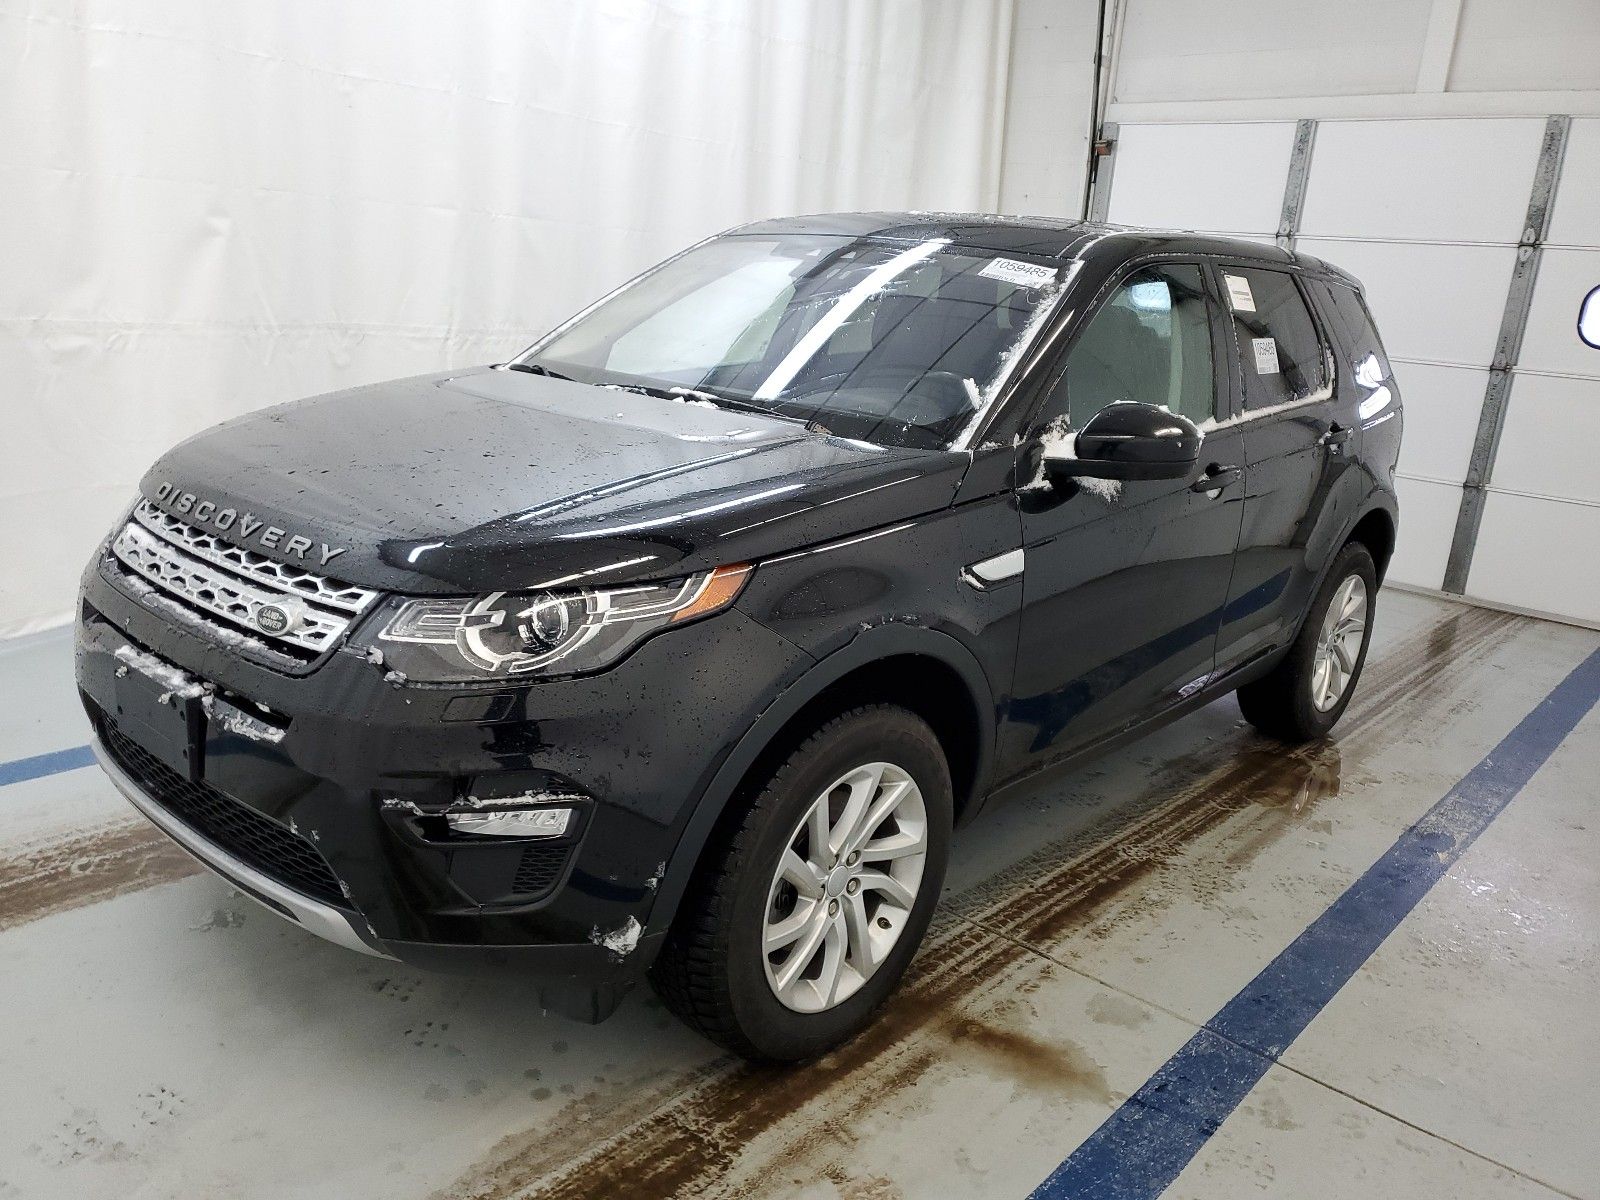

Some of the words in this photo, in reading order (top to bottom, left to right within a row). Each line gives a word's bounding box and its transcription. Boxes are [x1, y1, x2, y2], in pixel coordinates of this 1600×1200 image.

[994, 259, 1048, 278] 1059485
[155, 481, 346, 566] DISCOVERY
[262, 609, 280, 621] LAND
[260, 617, 282, 630] ROVER
